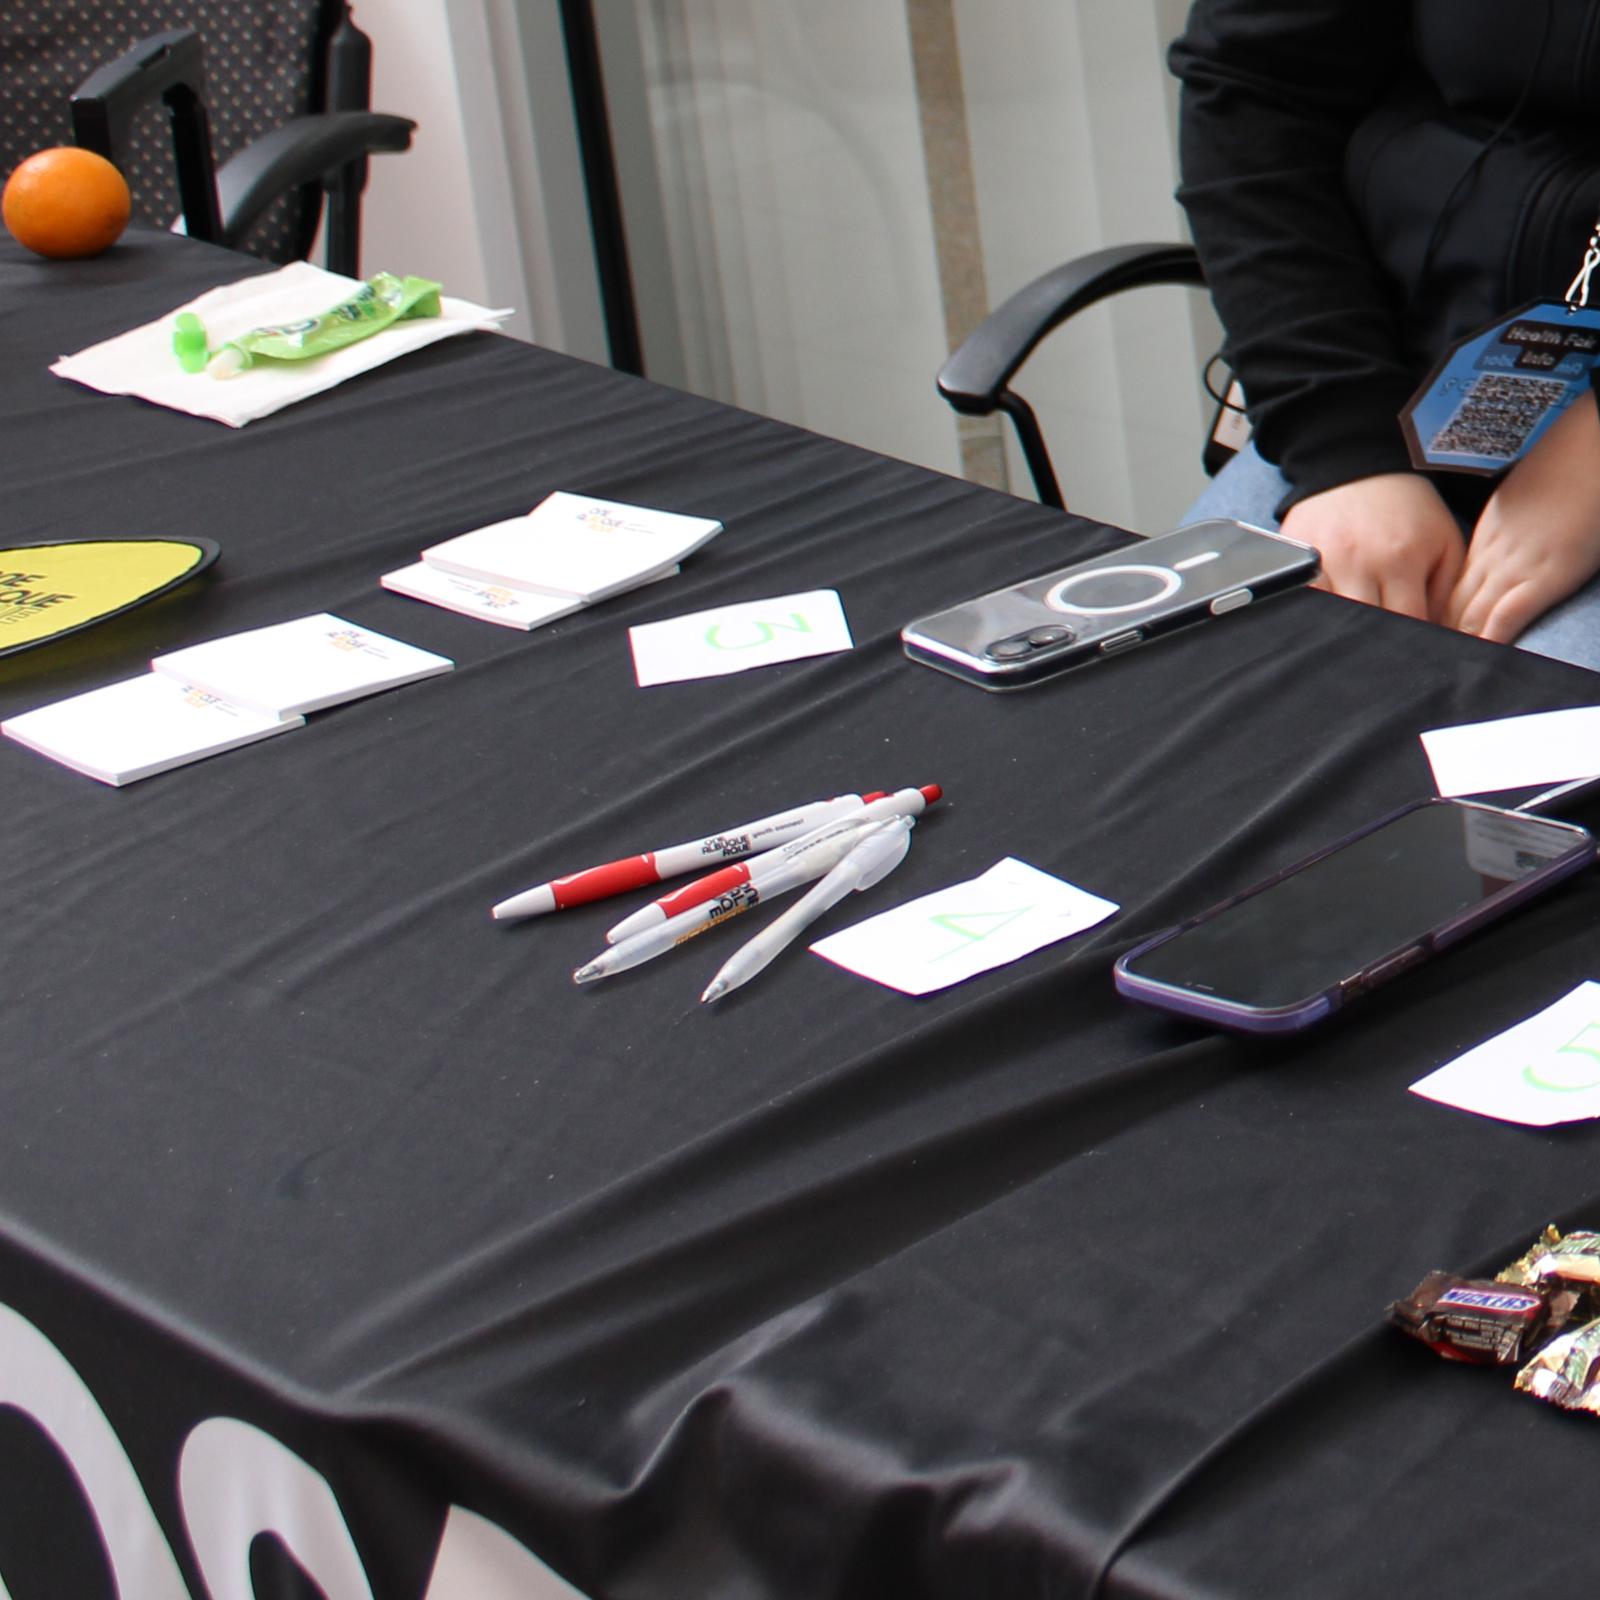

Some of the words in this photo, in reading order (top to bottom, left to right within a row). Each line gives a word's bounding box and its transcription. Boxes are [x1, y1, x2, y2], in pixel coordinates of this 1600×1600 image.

[1507, 325, 1562, 346] Health
[1521, 350, 1556, 367] Info
[1446, 1290, 1537, 1311] NICKERS
